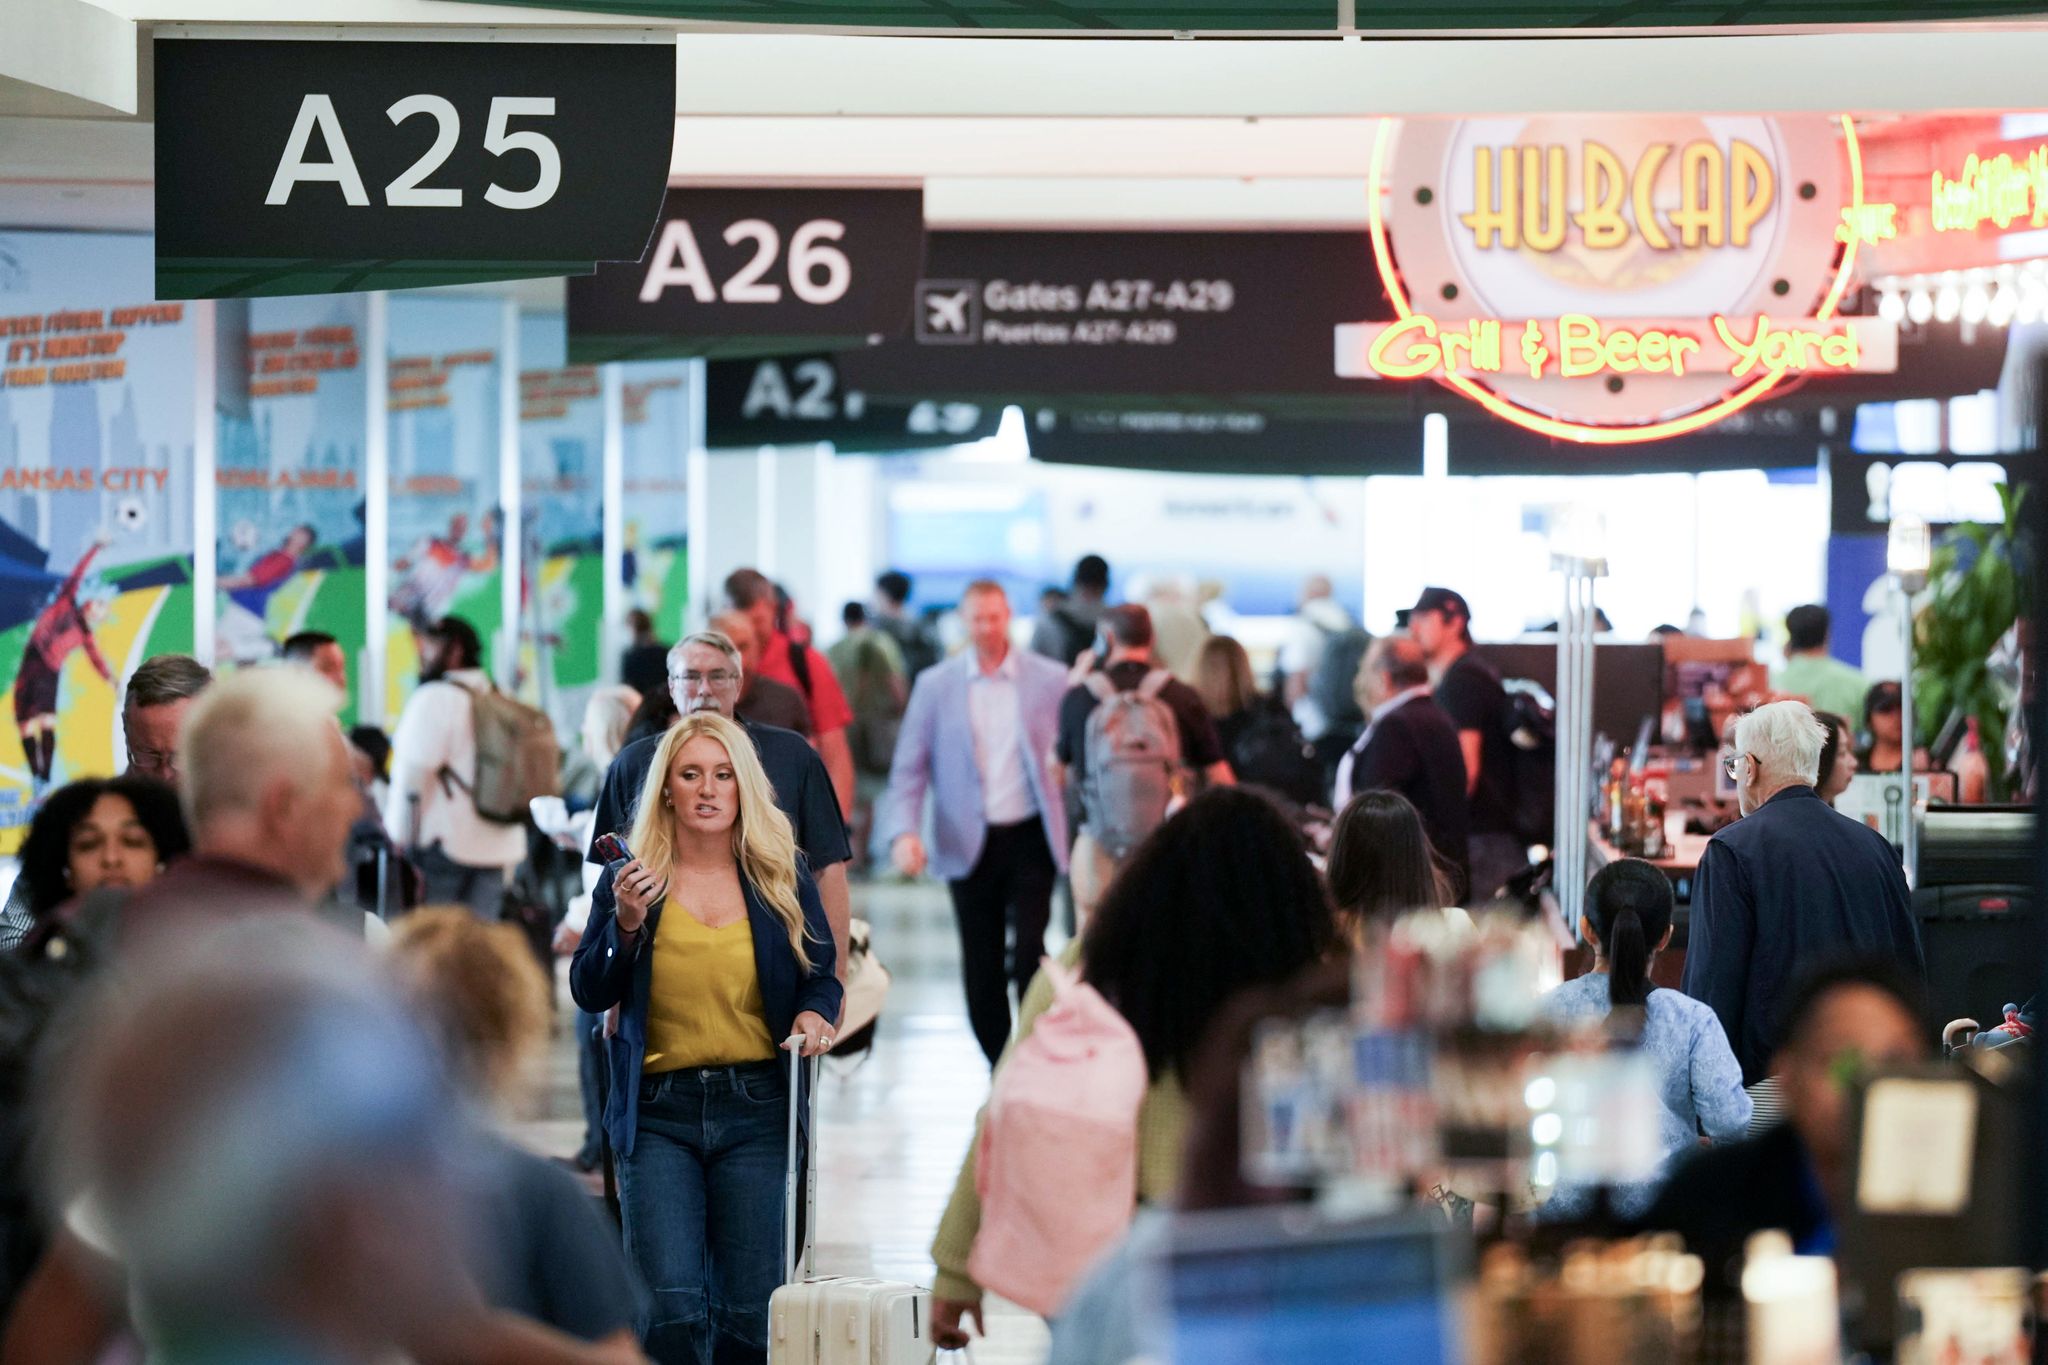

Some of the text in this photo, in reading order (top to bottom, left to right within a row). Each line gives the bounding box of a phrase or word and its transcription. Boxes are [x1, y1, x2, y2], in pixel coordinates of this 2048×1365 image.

[265, 93, 562, 210] A25
[1456, 138, 1775, 251] HUBCAP
[640, 219, 853, 305] A26
[983, 279, 1235, 313] Gates A27-A29
[1368, 313, 1859, 378] Grill & Beer Yard
[102, 468, 169, 491] CITY
